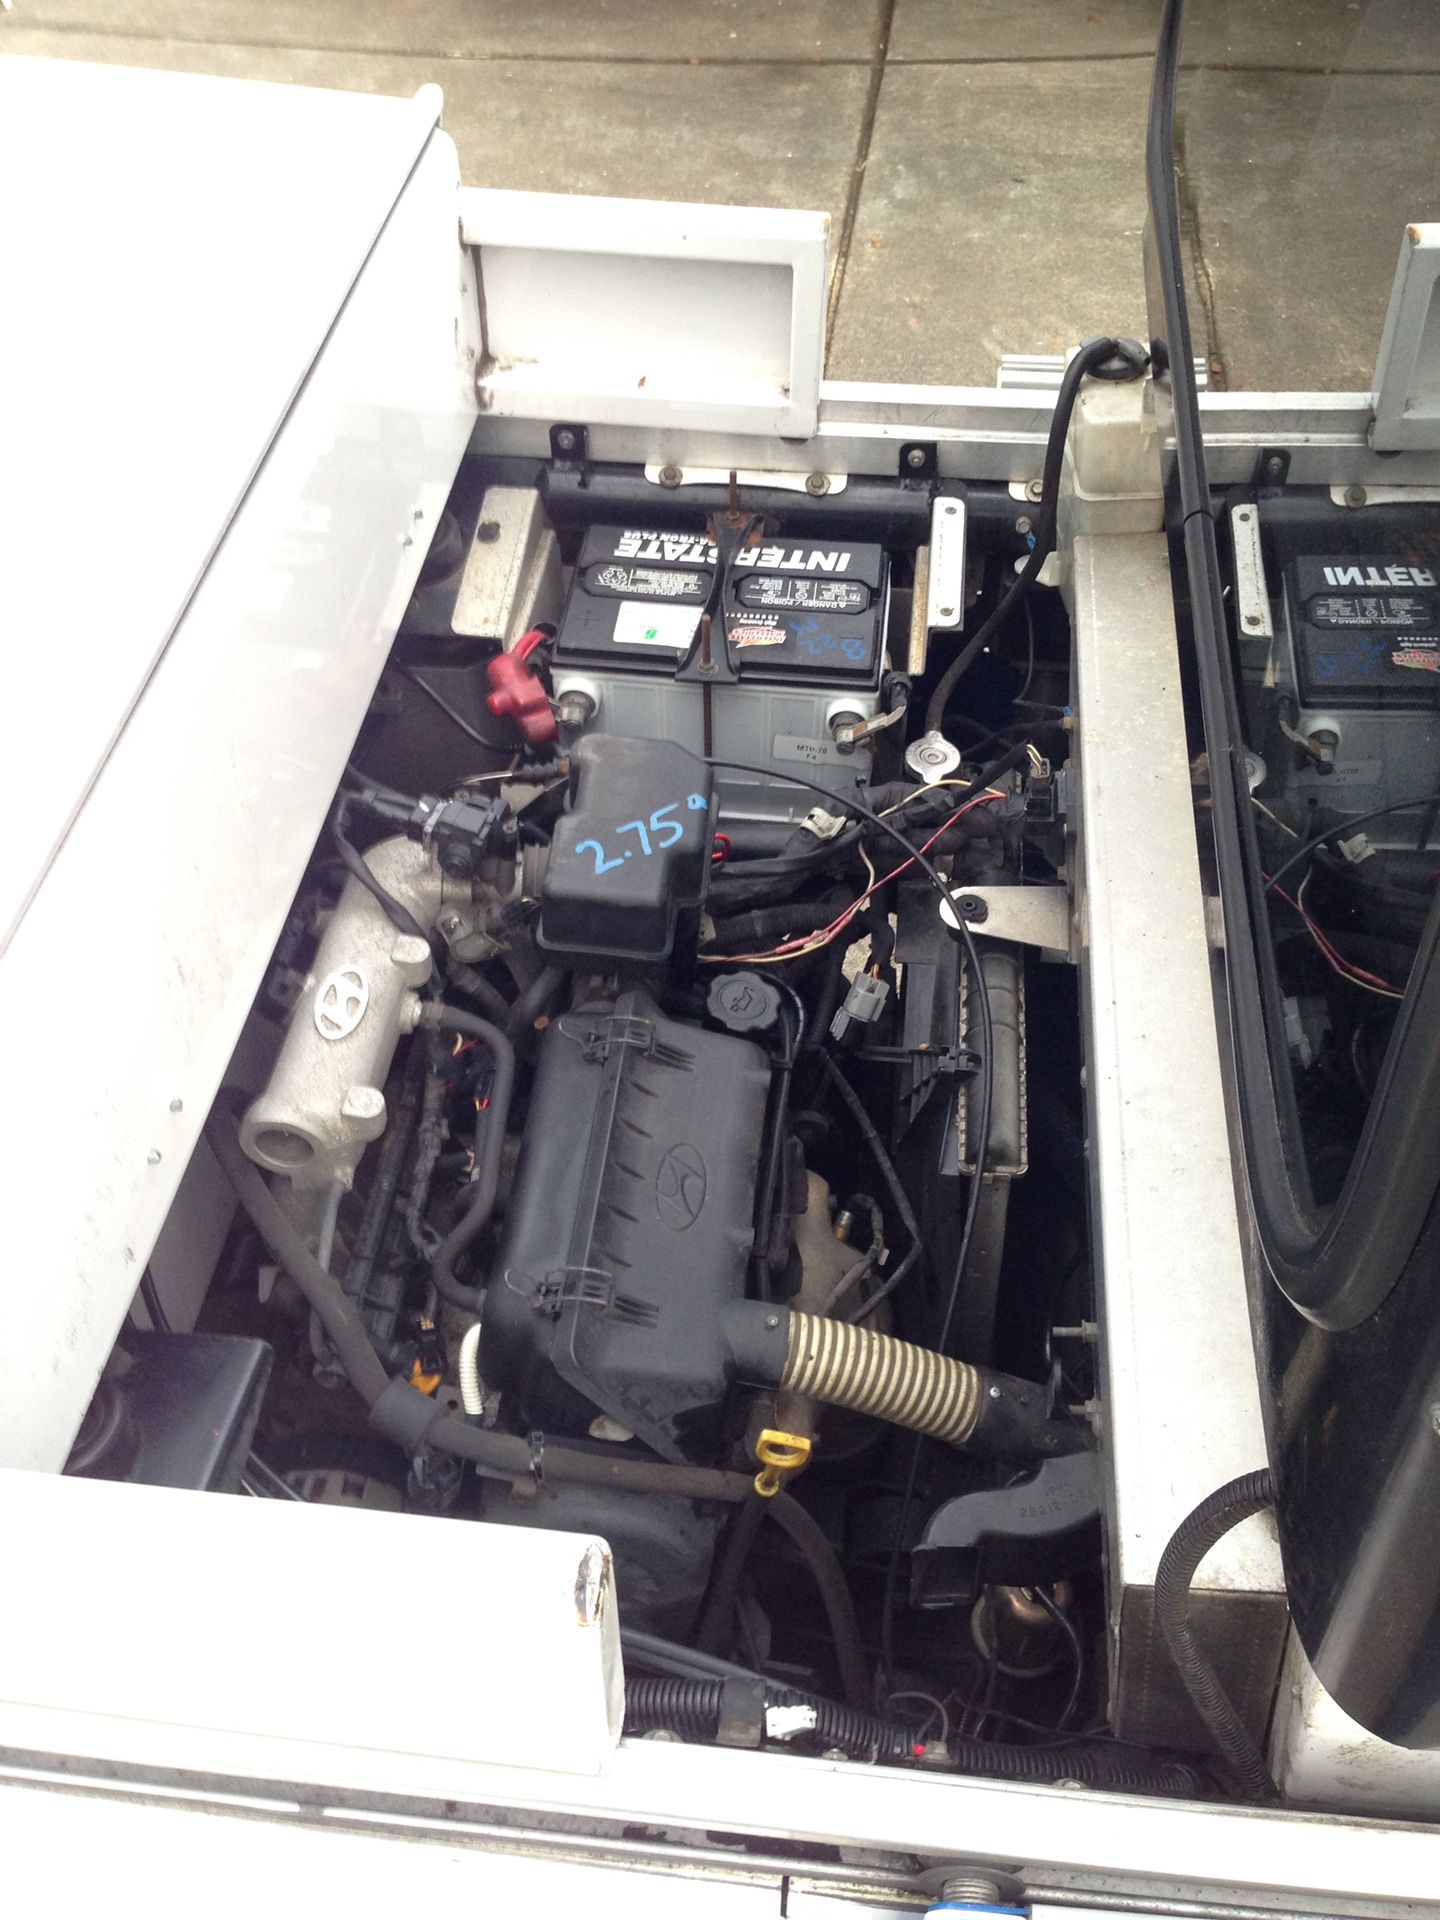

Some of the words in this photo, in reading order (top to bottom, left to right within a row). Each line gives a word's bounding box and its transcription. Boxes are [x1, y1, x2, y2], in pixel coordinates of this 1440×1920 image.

[623, 529, 658, 541] PLUS
[761, 597, 794, 607] POISON
[802, 600, 838, 609] DANGER
